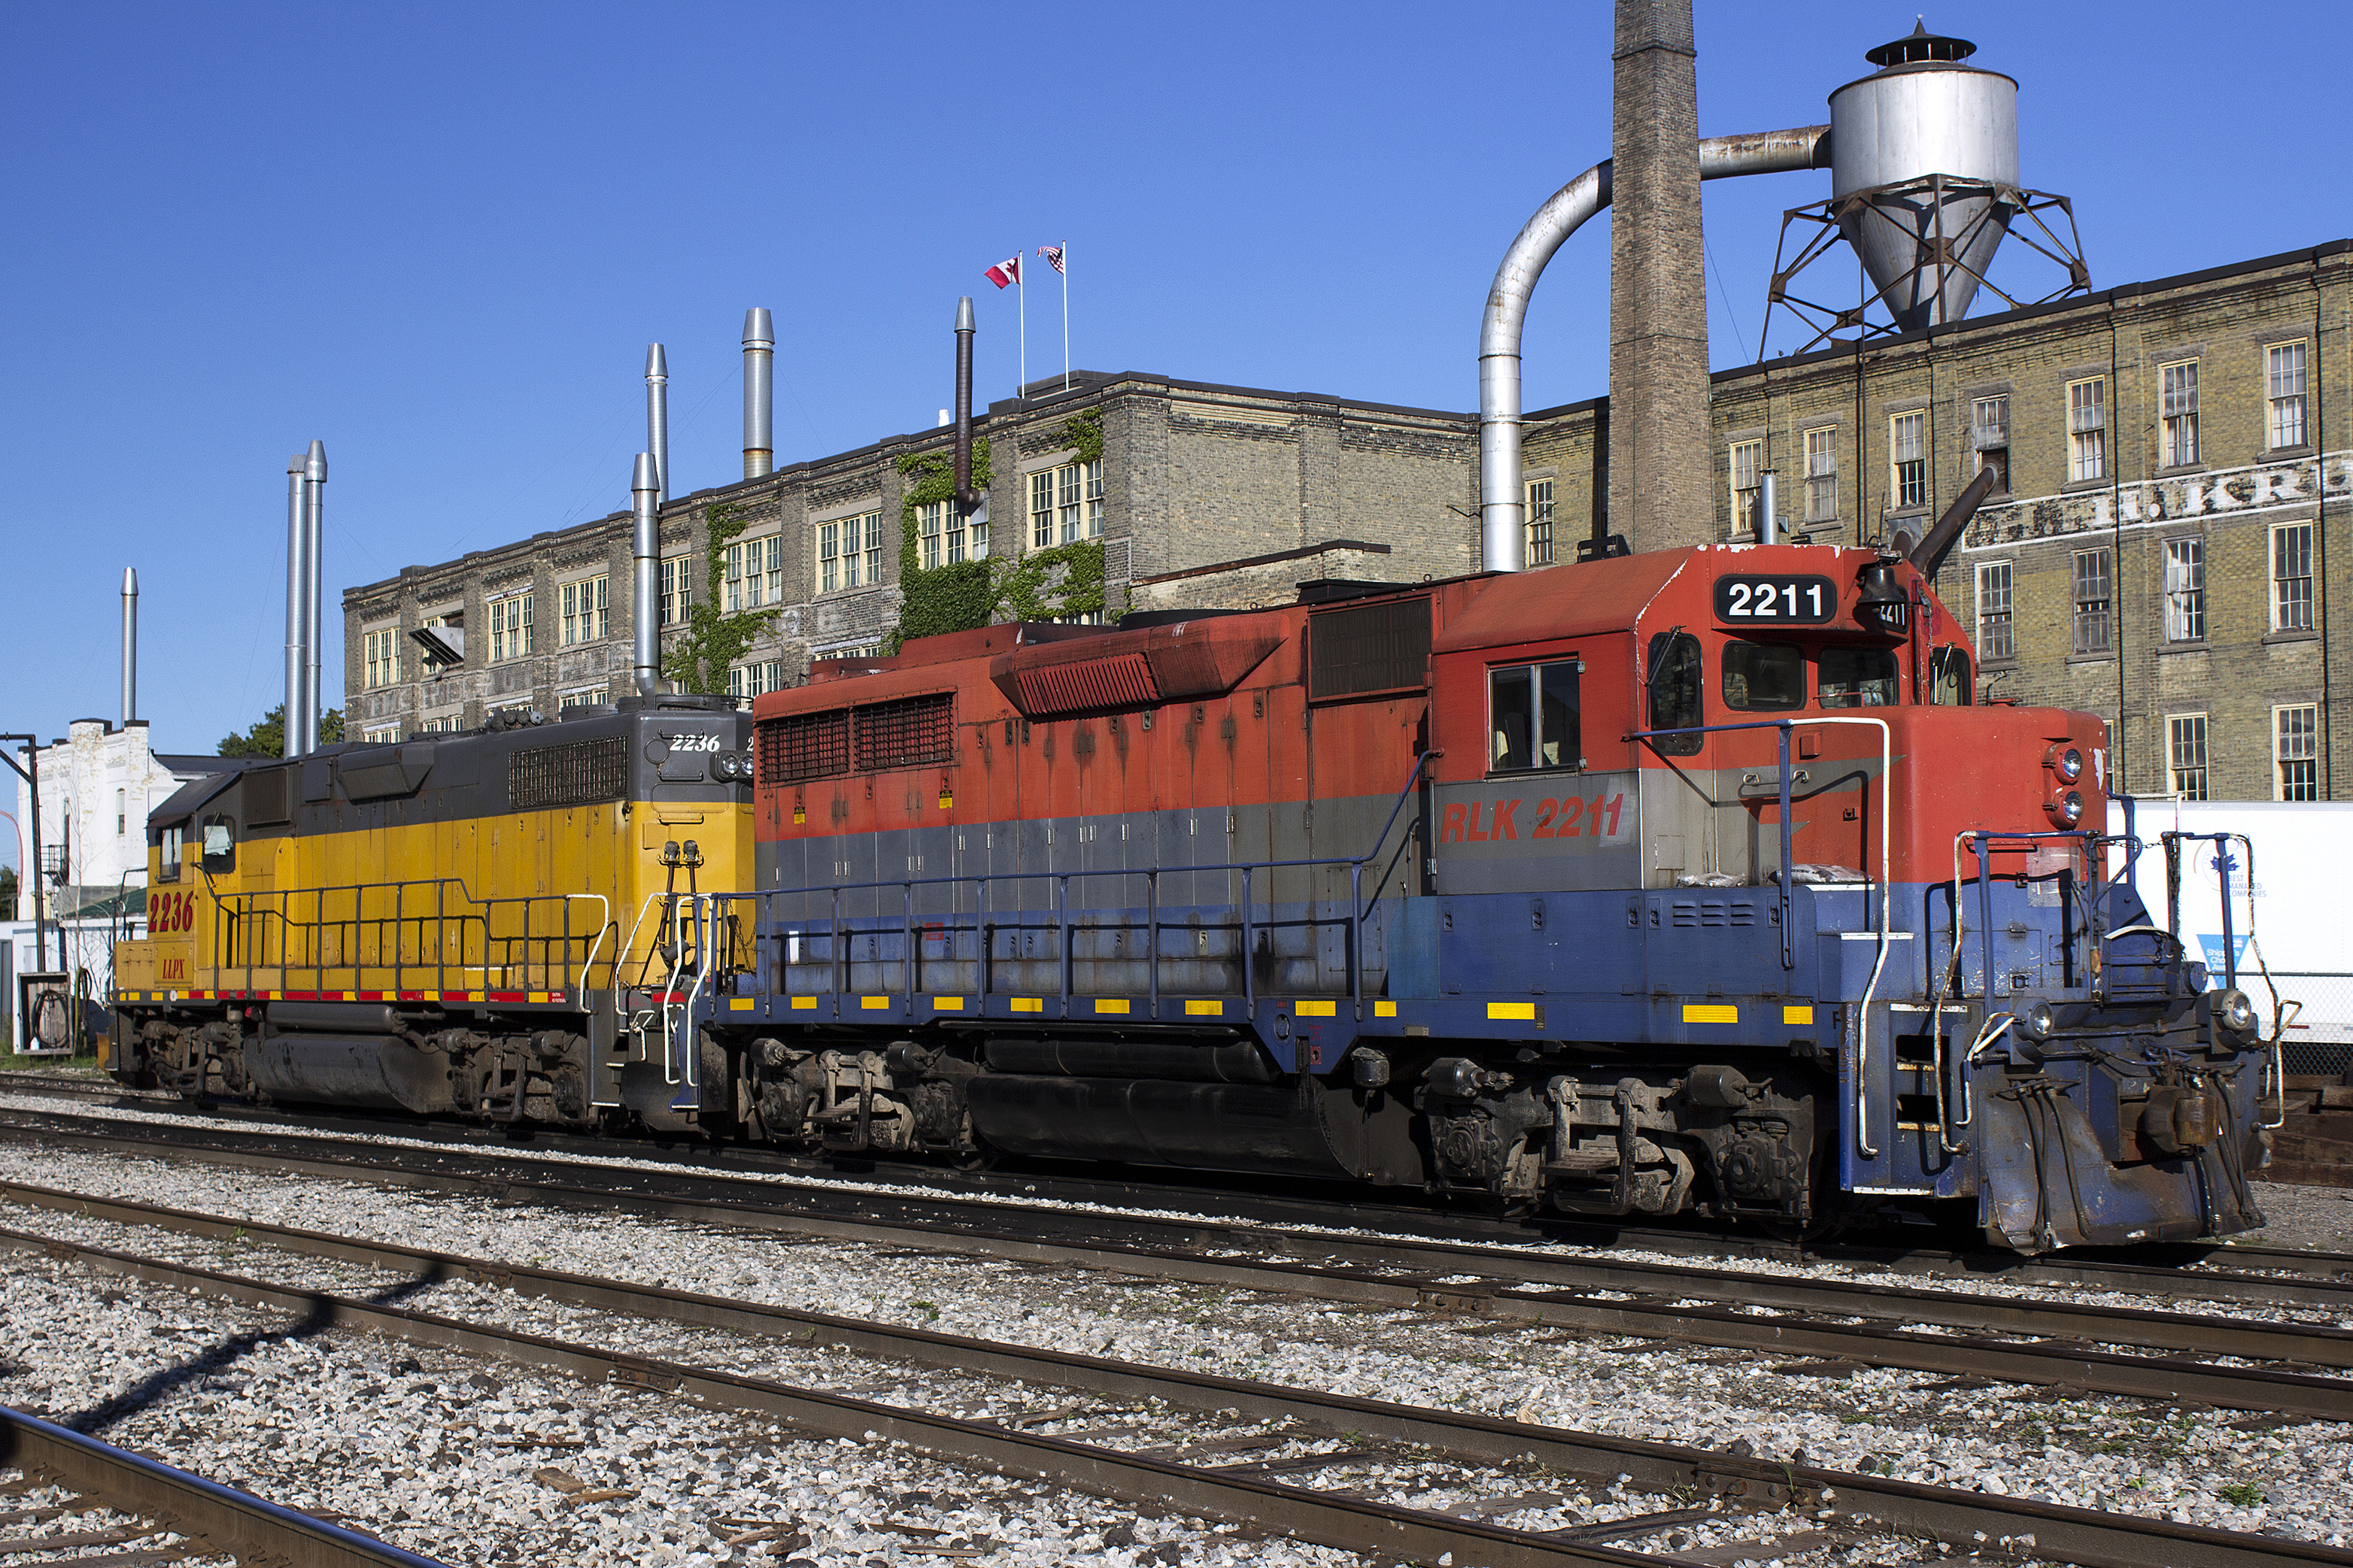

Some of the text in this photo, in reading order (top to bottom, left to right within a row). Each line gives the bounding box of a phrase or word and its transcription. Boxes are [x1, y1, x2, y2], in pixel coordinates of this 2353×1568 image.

[1729, 584, 1822, 617] 2211
[669, 734, 721, 753] 2236
[1440, 793, 1623, 843] RLK 2211
[147, 890, 194, 933] 2236
[162, 959, 185, 979] LLPX
